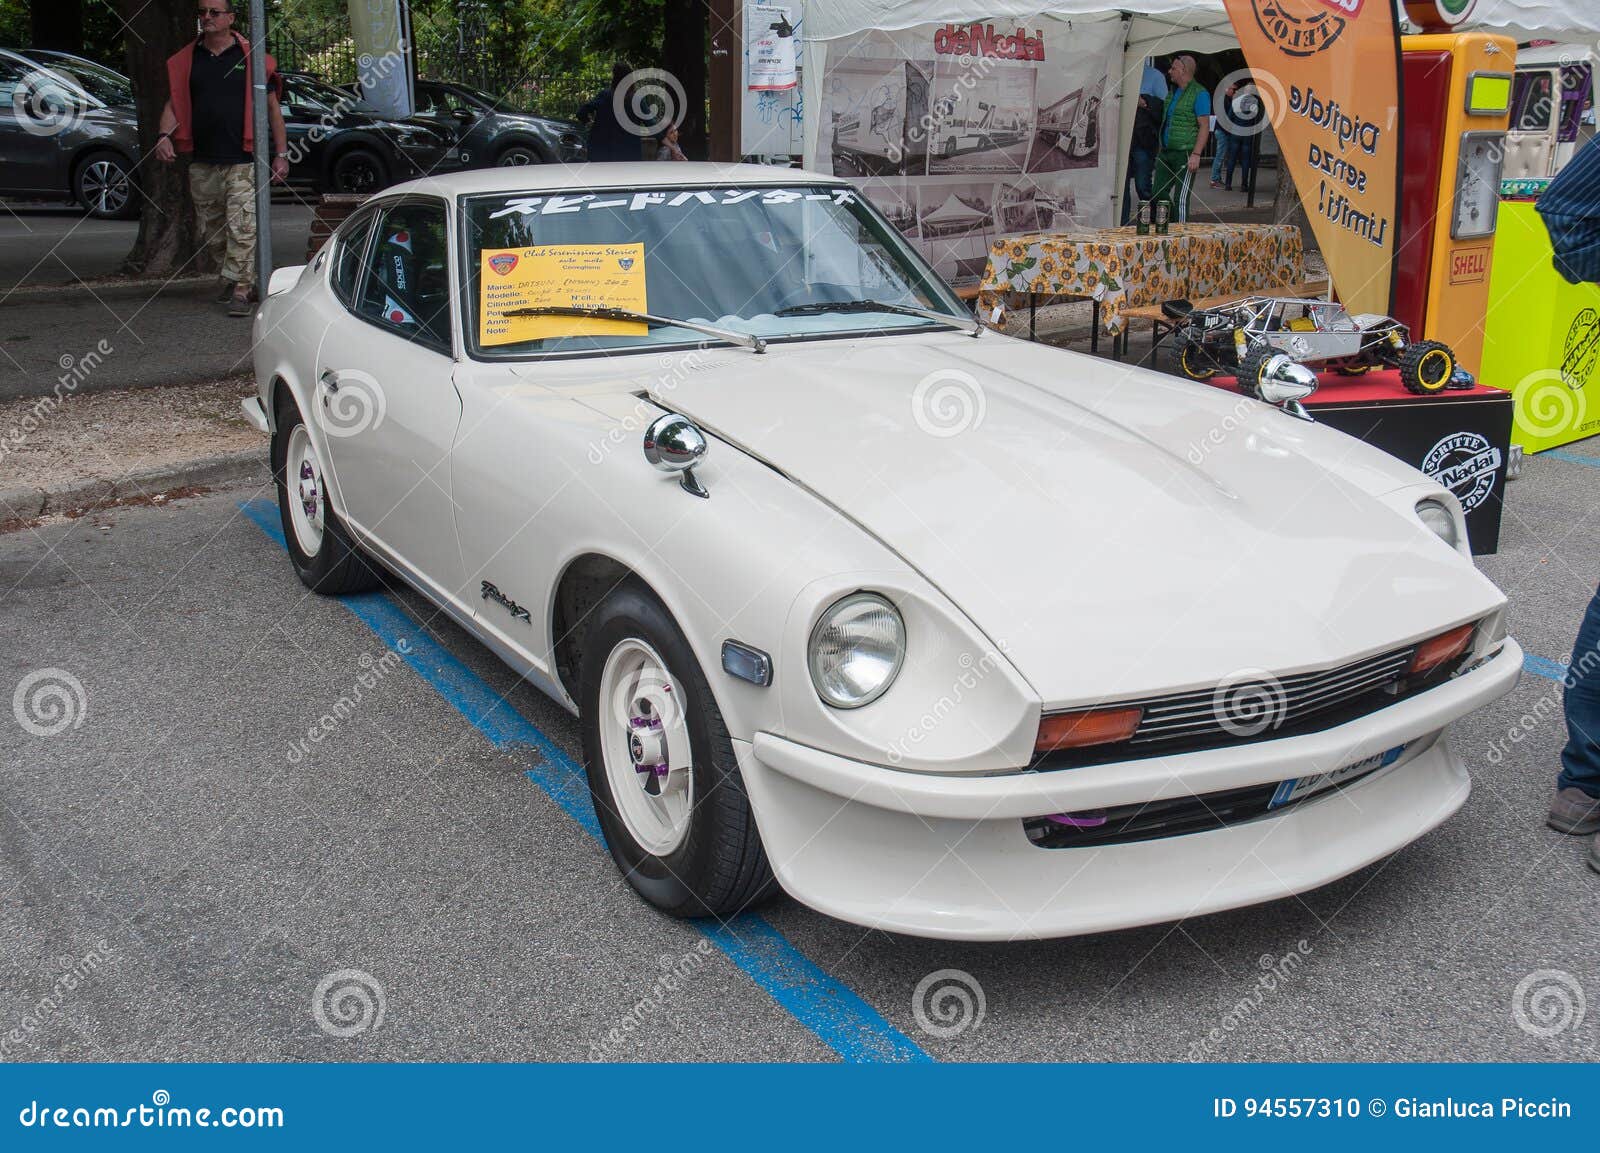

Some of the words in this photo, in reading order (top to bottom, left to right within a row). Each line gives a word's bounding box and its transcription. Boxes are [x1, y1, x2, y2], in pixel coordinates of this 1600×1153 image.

[1453, 254, 1484, 275] SHELL
[1426, 436, 1481, 471] SCRITTE
[1434, 450, 1495, 488] Nadai
